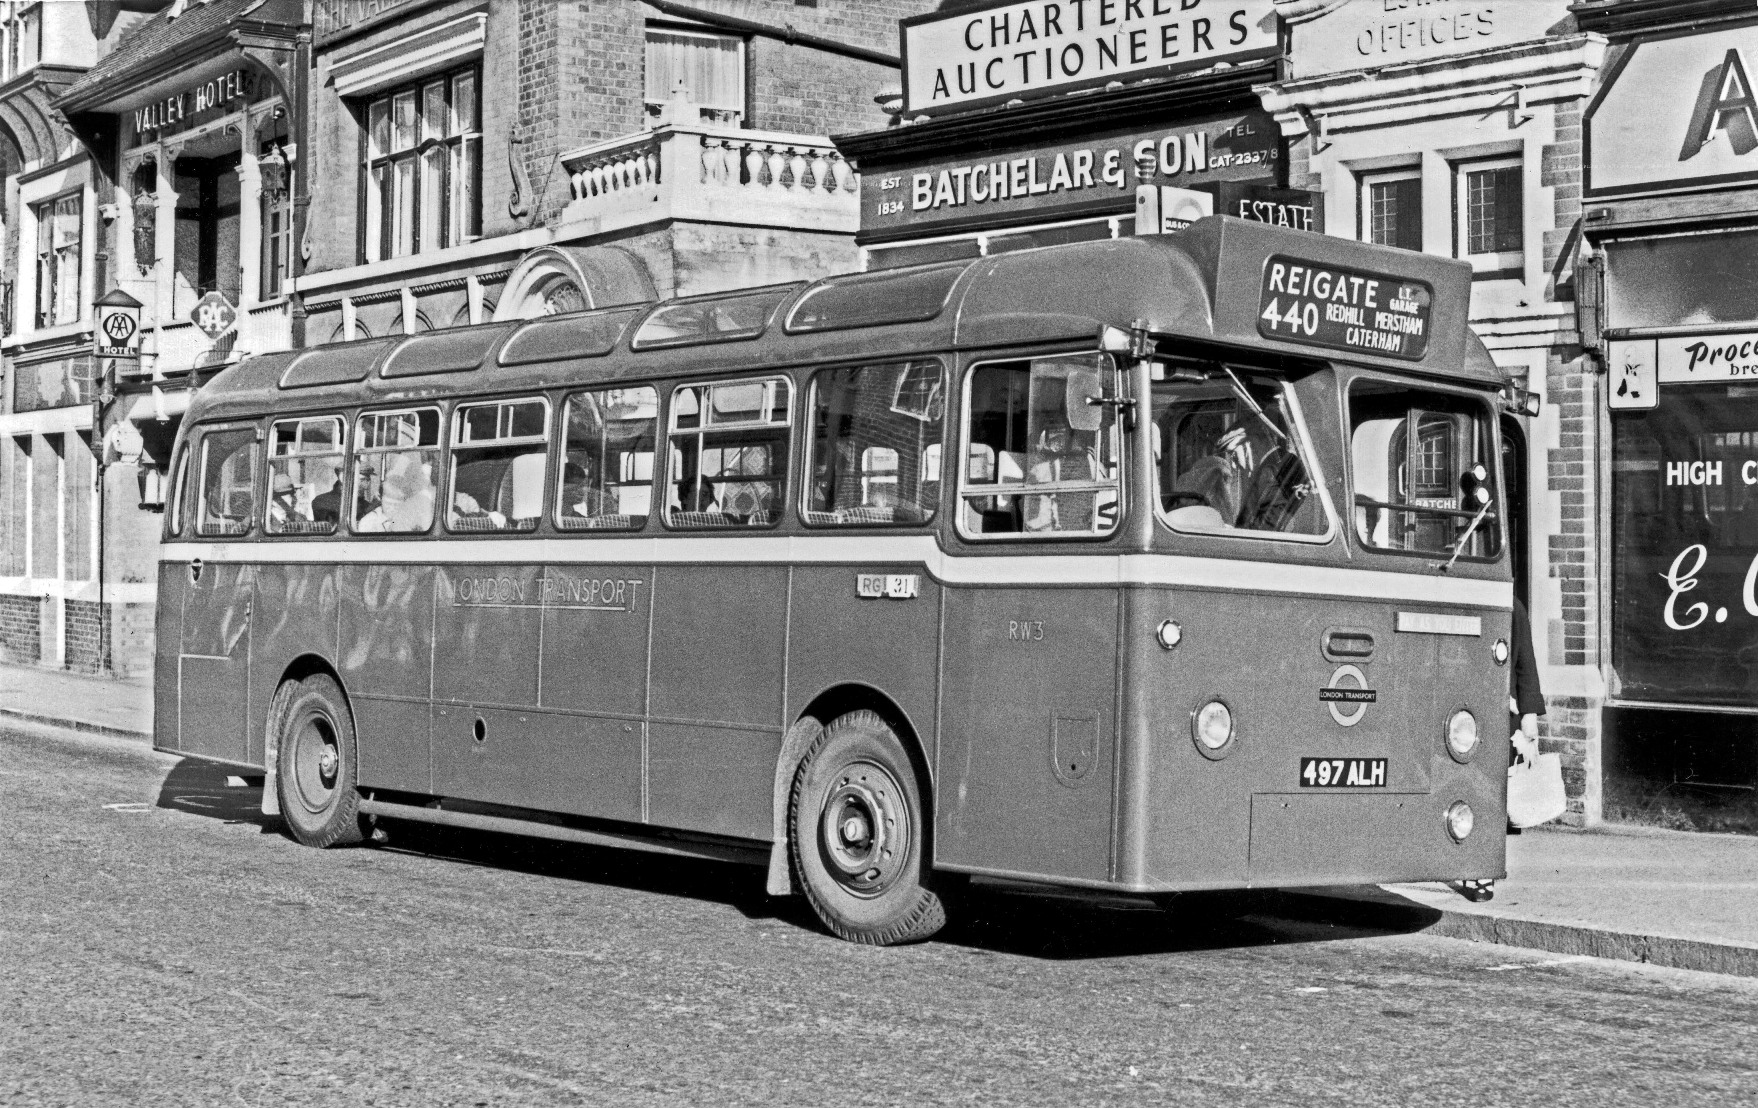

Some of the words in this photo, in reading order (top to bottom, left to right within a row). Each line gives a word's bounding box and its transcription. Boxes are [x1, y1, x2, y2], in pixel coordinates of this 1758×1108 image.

[1357, 9, 1493, 55] OFFICES
[932, 10, 1248, 100] AUCTIONEERS
[135, 93, 184, 133] VALLEY
[196, 70, 244, 112] HOTEL
[1227, 125, 1256, 138] TEL
[881, 176, 902, 190] EST
[912, 149, 1095, 211] BATCHELAR
[1102, 149, 1125, 189] &
[1133, 131, 1207, 178] SON
[878, 201, 905, 216] 1834
[1239, 199, 1314, 232] ESTATE
[1268, 263, 1380, 309] REIGATE
[199, 302, 228, 332] RAC
[1261, 297, 1319, 336] 440
[1326, 302, 1365, 327] REDHILL
[1374, 311, 1424, 336] MERSTHAM
[1389, 298, 1420, 315] GARAGE
[110, 315, 129, 337] AA
[1345, 326, 1401, 352] CATERHAM
[103, 346, 135, 355] HOTEL
[1666, 460, 1723, 486] HIGH
[451, 577, 525, 606] LONDON
[535, 576, 643, 611] TRANSPORT
[863, 577, 880, 593] RG
[1009, 620, 1044, 641] RW3
[1320, 691, 1344, 699] LONDON
[1344, 692, 1376, 700] TRANSPORT
[1303, 760, 1345, 786] 497
[1346, 760, 1385, 786] ALH
